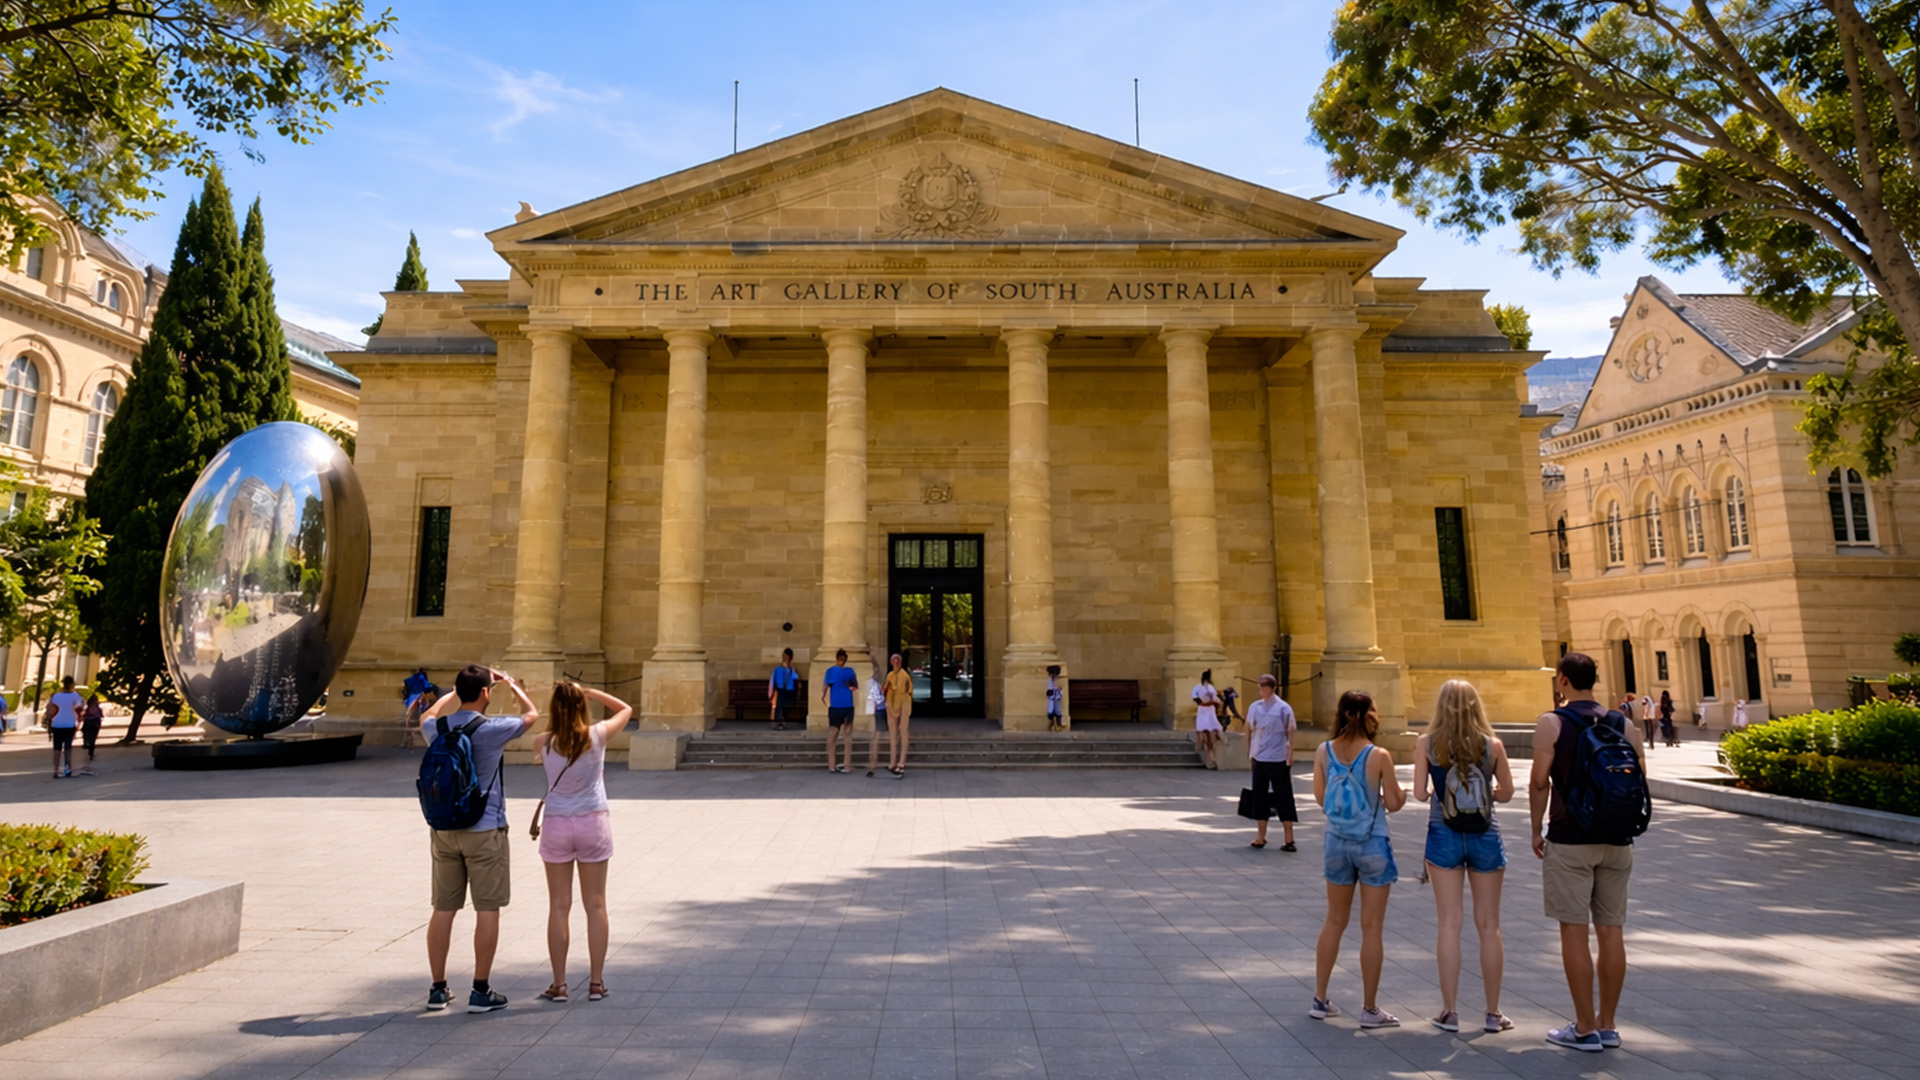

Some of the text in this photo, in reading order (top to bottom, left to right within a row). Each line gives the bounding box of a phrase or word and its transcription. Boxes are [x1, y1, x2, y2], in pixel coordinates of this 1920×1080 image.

[635, 282, 1256, 301] THE ART GALLERY OF SOUTH AUSTRALIA
